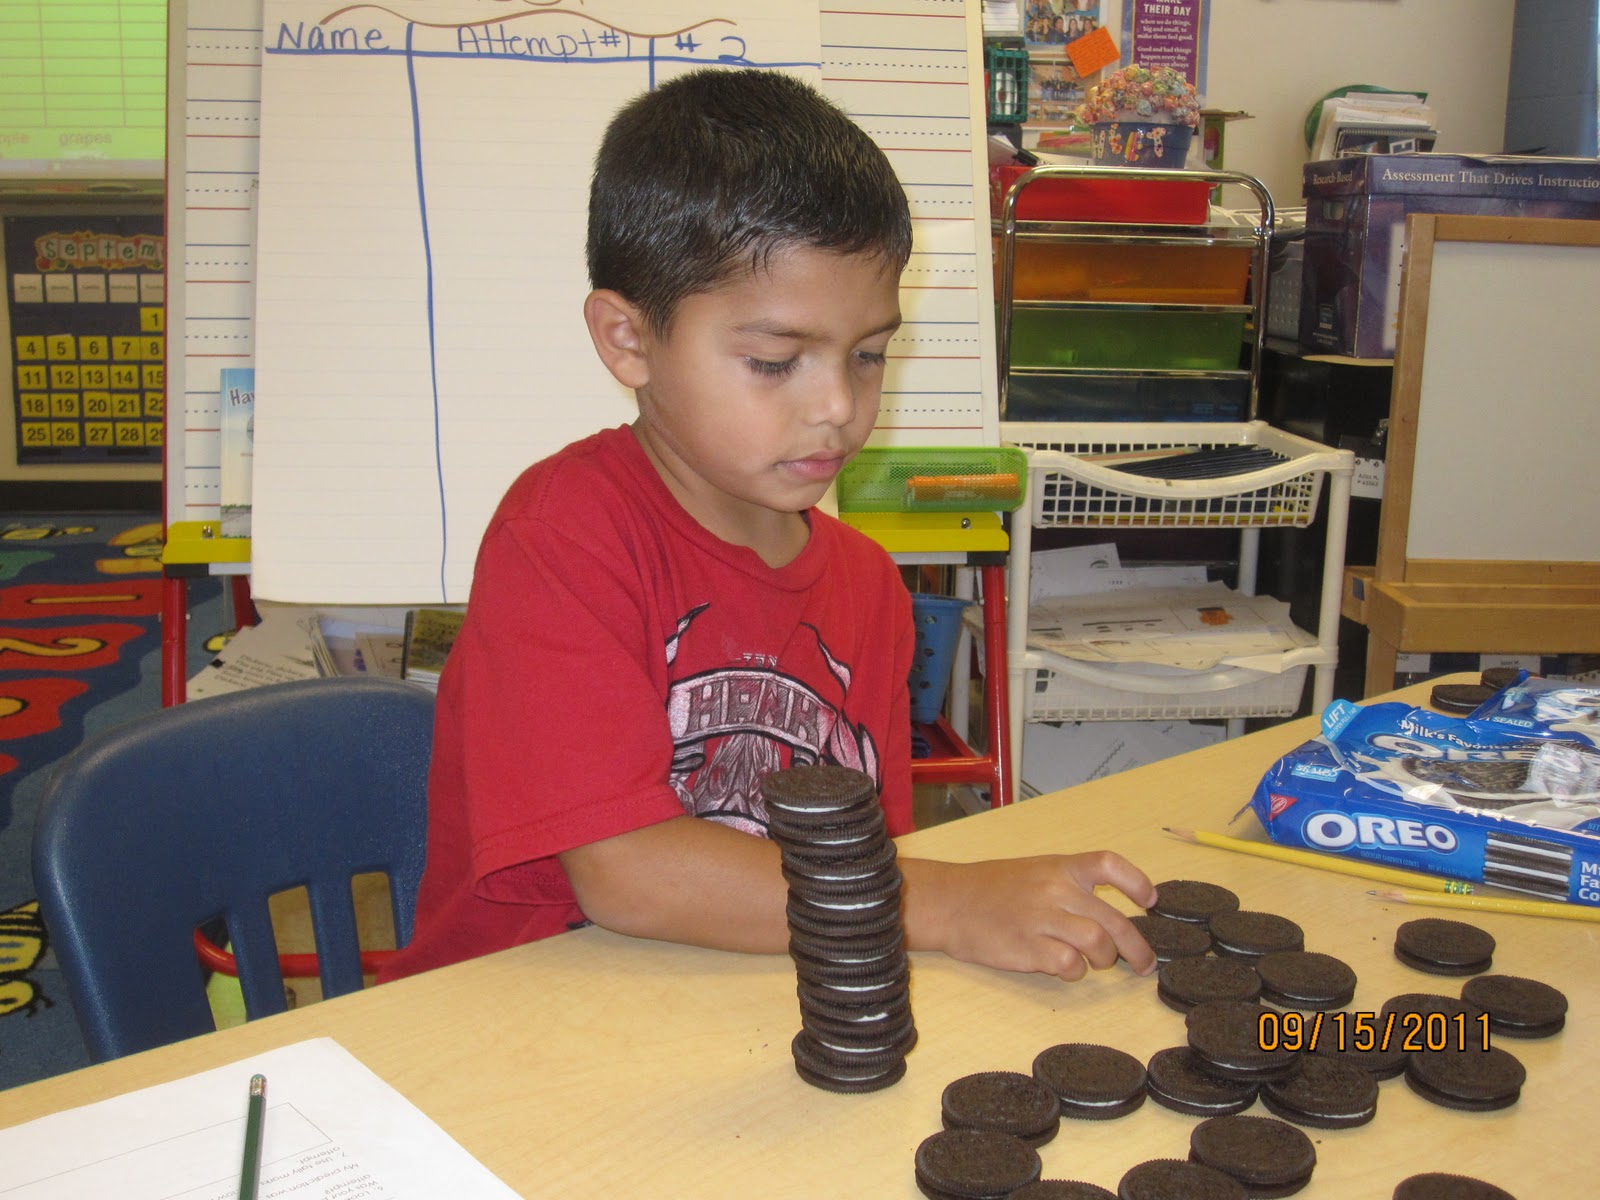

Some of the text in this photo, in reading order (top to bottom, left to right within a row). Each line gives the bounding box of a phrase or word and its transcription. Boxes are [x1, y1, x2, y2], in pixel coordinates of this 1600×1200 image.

[1144, 4, 1191, 16] THEIR DAY
[277, 22, 390, 52] Name
[59, 132, 112, 146] grapes
[1382, 168, 1455, 183] Assessment
[1459, 171, 1489, 184] That
[1494, 173, 1534, 185] Drives
[152, 312, 160, 327] 1
[26, 341, 159, 355] 4 5 6 7 8
[24, 370, 163, 385] 11 12 13 14 15
[27, 399, 44, 413] 18
[57, 399, 74, 413] 19
[89, 399, 107, 413] 20
[118, 399, 135, 413] 21
[27, 428, 46, 441] 25
[57, 427, 75, 441] 26
[90, 427, 108, 442] 27
[120, 427, 139, 442] 28
[1324, 703, 1347, 729] LIFT
[1493, 716, 1533, 727] SEALED
[1400, 719, 1445, 741] Milk's
[1448, 733, 1509, 750] Favorite
[1306, 813, 1457, 851] OREO
[292, 1163, 313, 1174] tally
[315, 1157, 334, 1166] Use
[259, 1171, 290, 1186] marks
[266, 1162, 359, 1199] My prediction was
[324, 1173, 371, 1194] attempt?
[355, 1180, 378, 1190] Was
